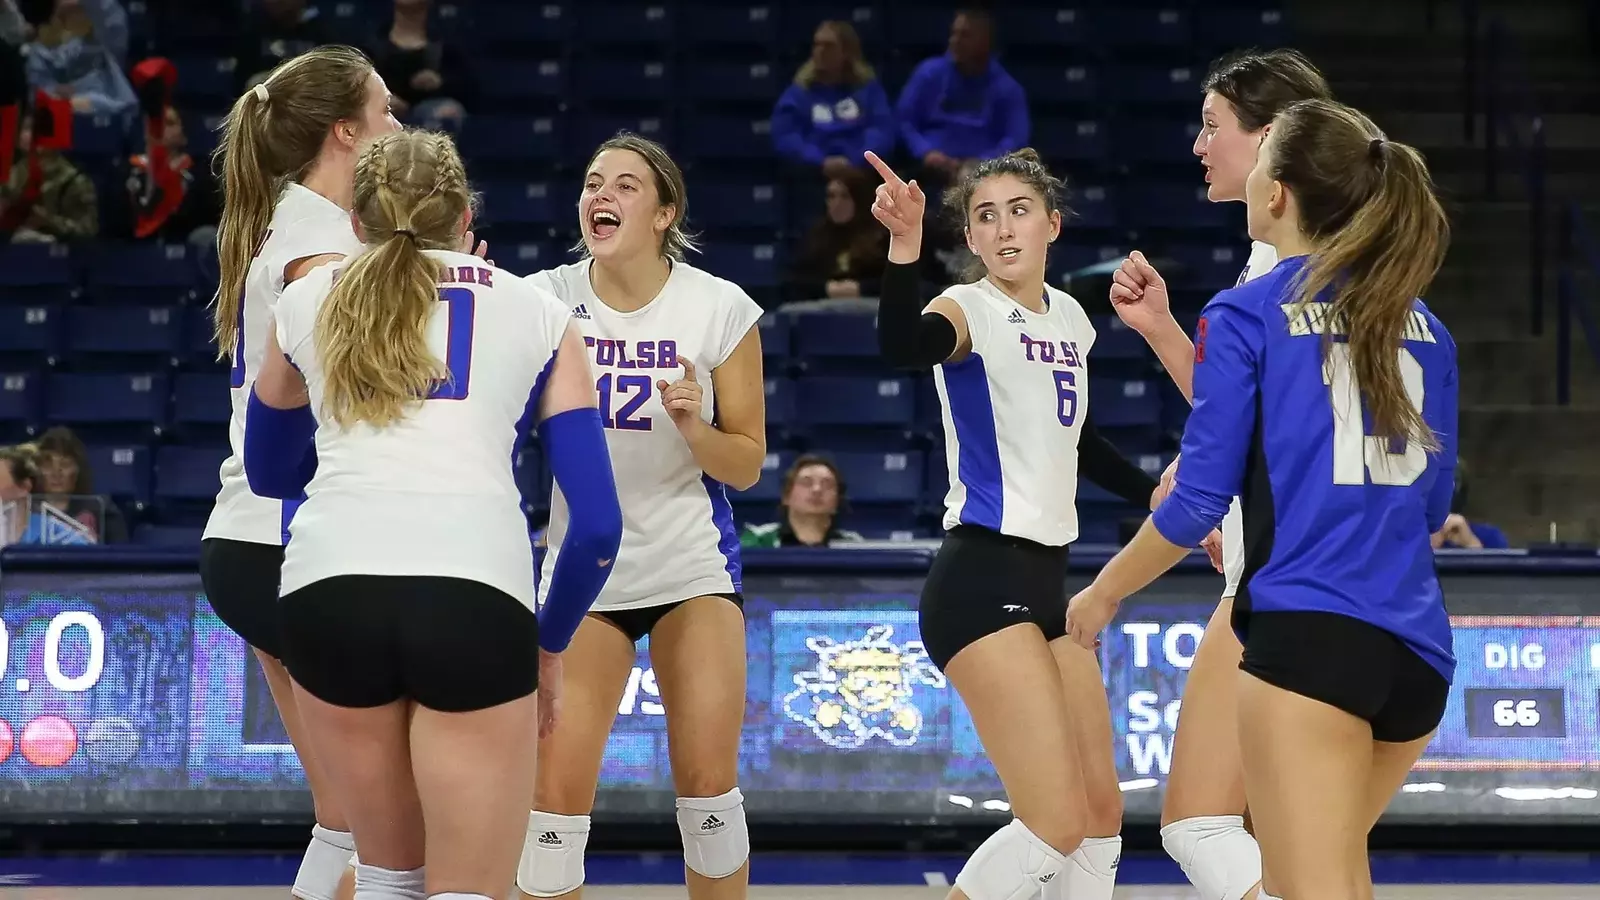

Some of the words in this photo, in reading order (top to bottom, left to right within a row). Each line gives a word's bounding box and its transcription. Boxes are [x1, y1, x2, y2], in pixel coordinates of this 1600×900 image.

[596, 372, 652, 431] 12
[1052, 370, 1078, 427] 6
[0, 611, 105, 692] .0
[1484, 642, 1546, 671] DIG
[1493, 699, 1540, 727] 66
